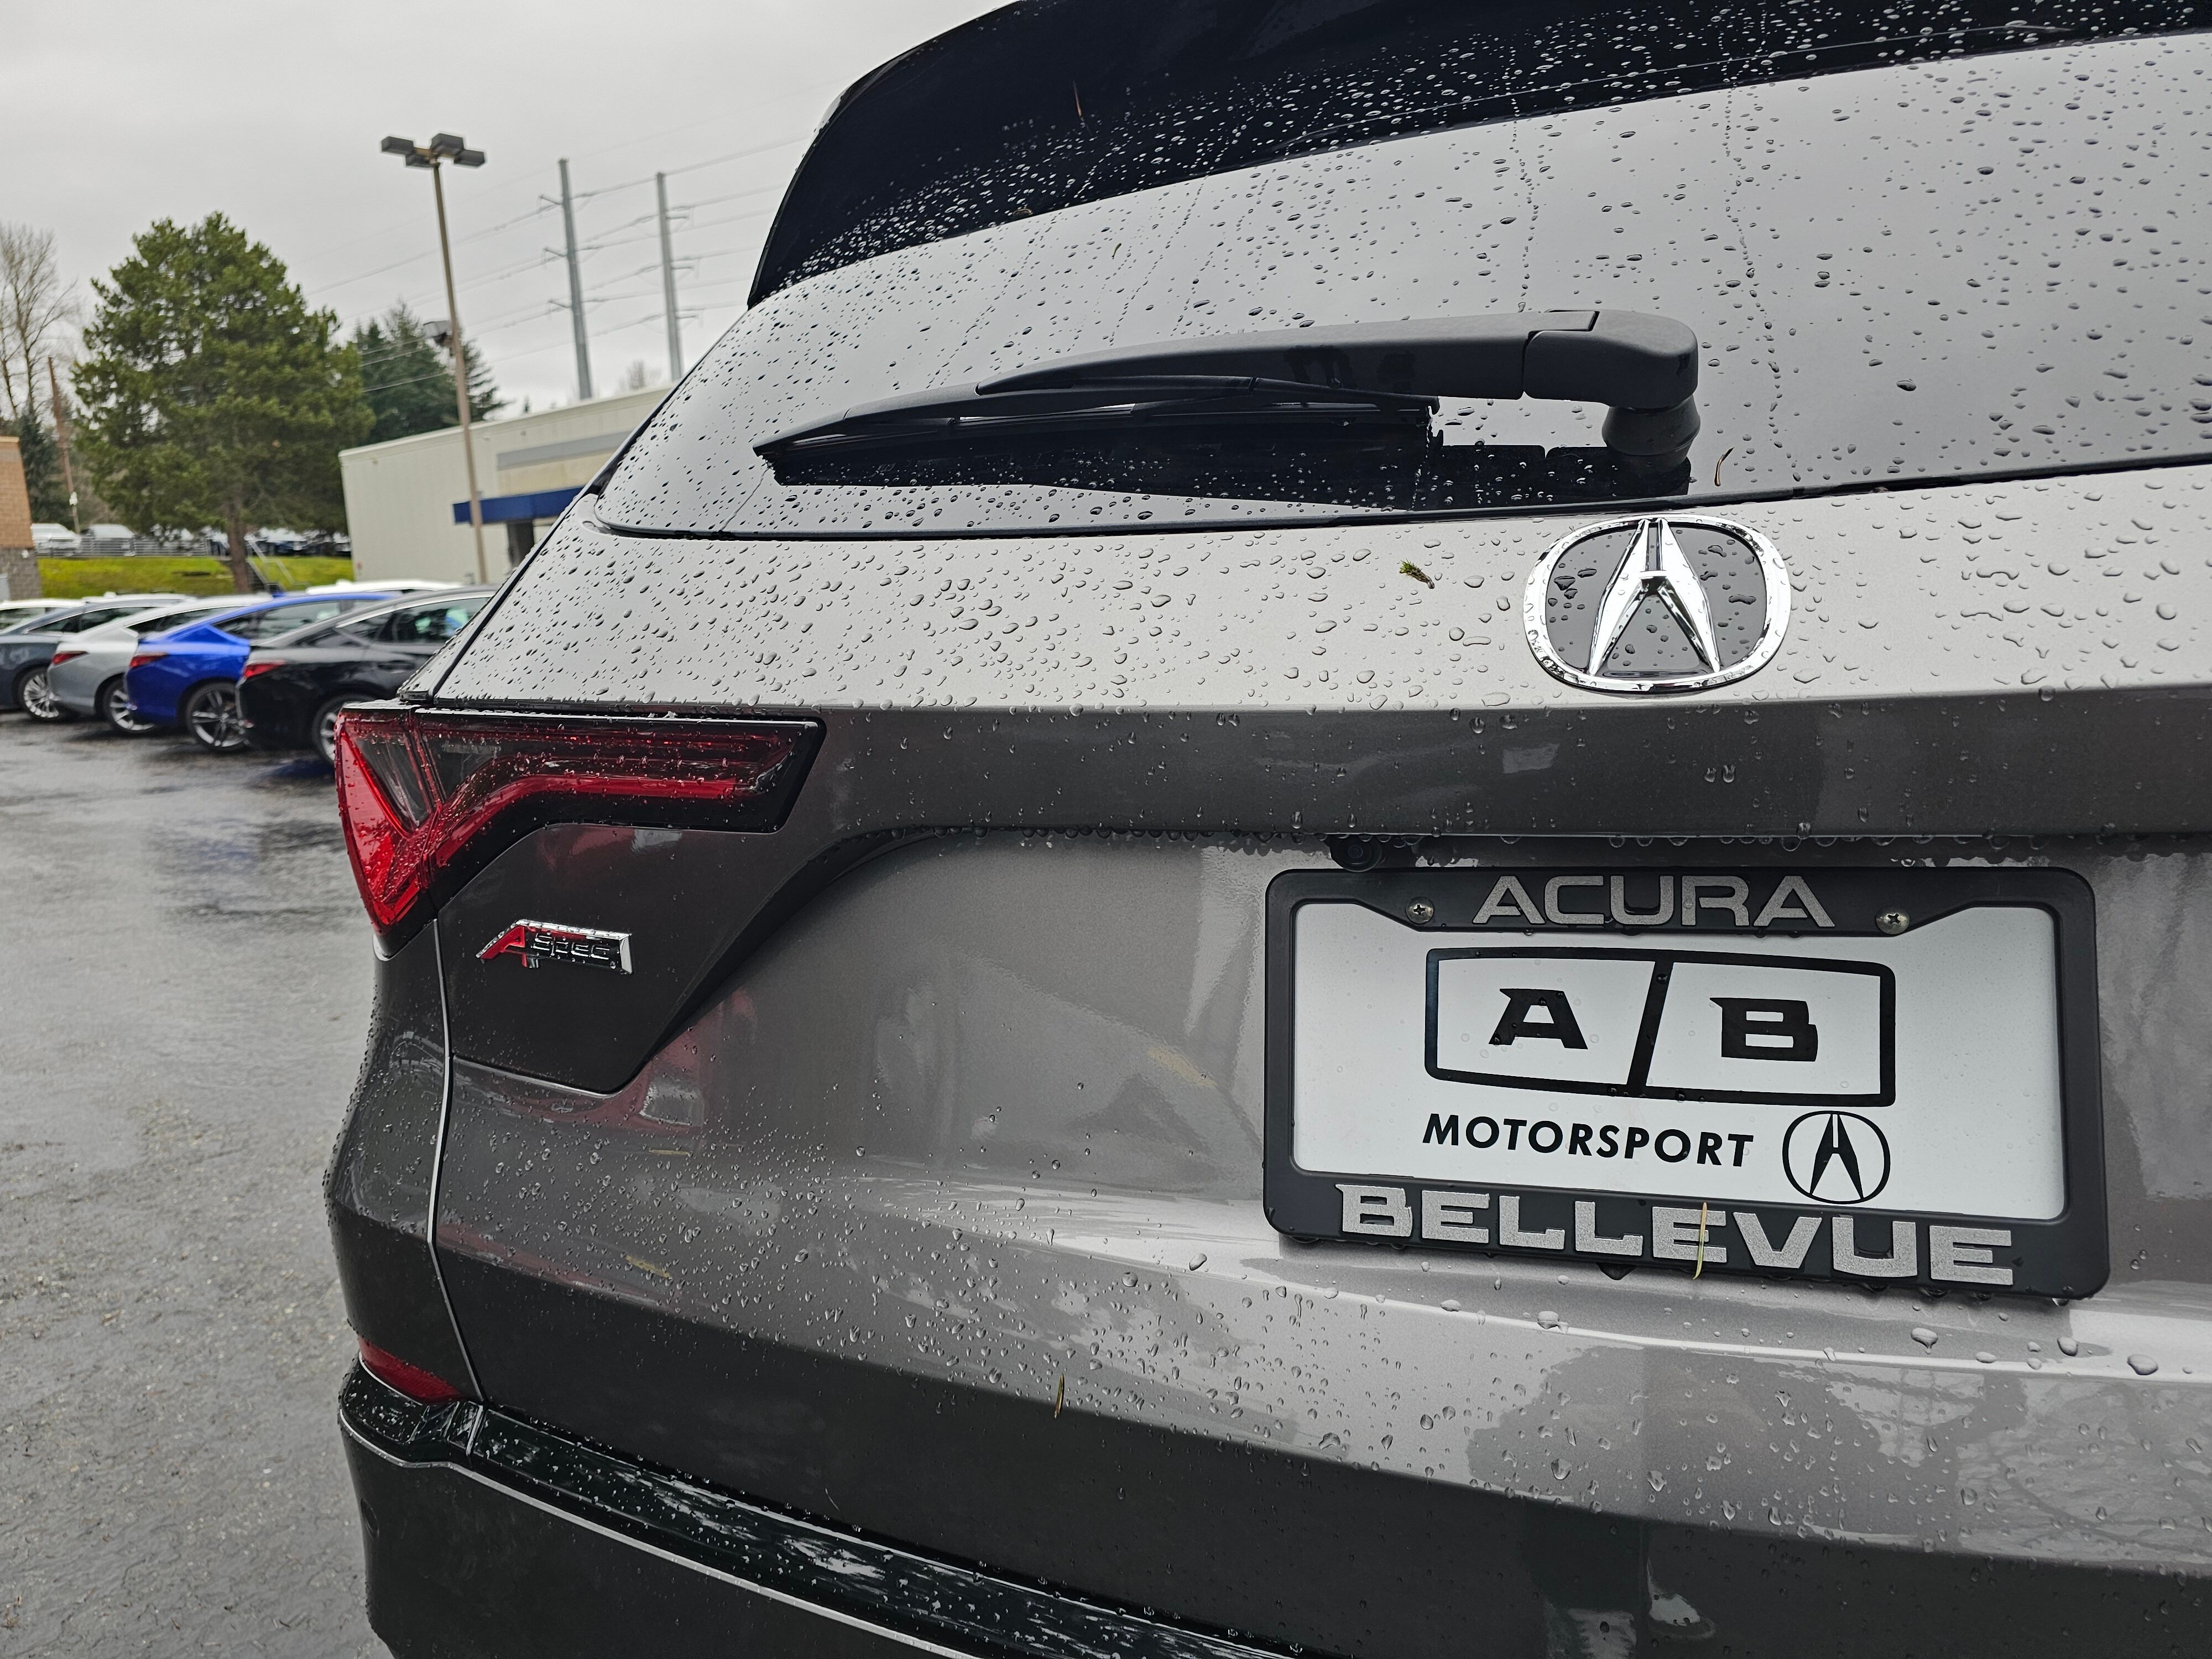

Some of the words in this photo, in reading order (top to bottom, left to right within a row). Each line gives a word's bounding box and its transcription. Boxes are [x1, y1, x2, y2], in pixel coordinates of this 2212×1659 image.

[1473, 875, 1835, 927] ACURA
[1488, 988, 1588, 1050] A
[1710, 997, 1819, 1062] B
[1422, 1113, 1754, 1168] MOTORSPORT
[1335, 1183, 2014, 1286] BELLEVUE
